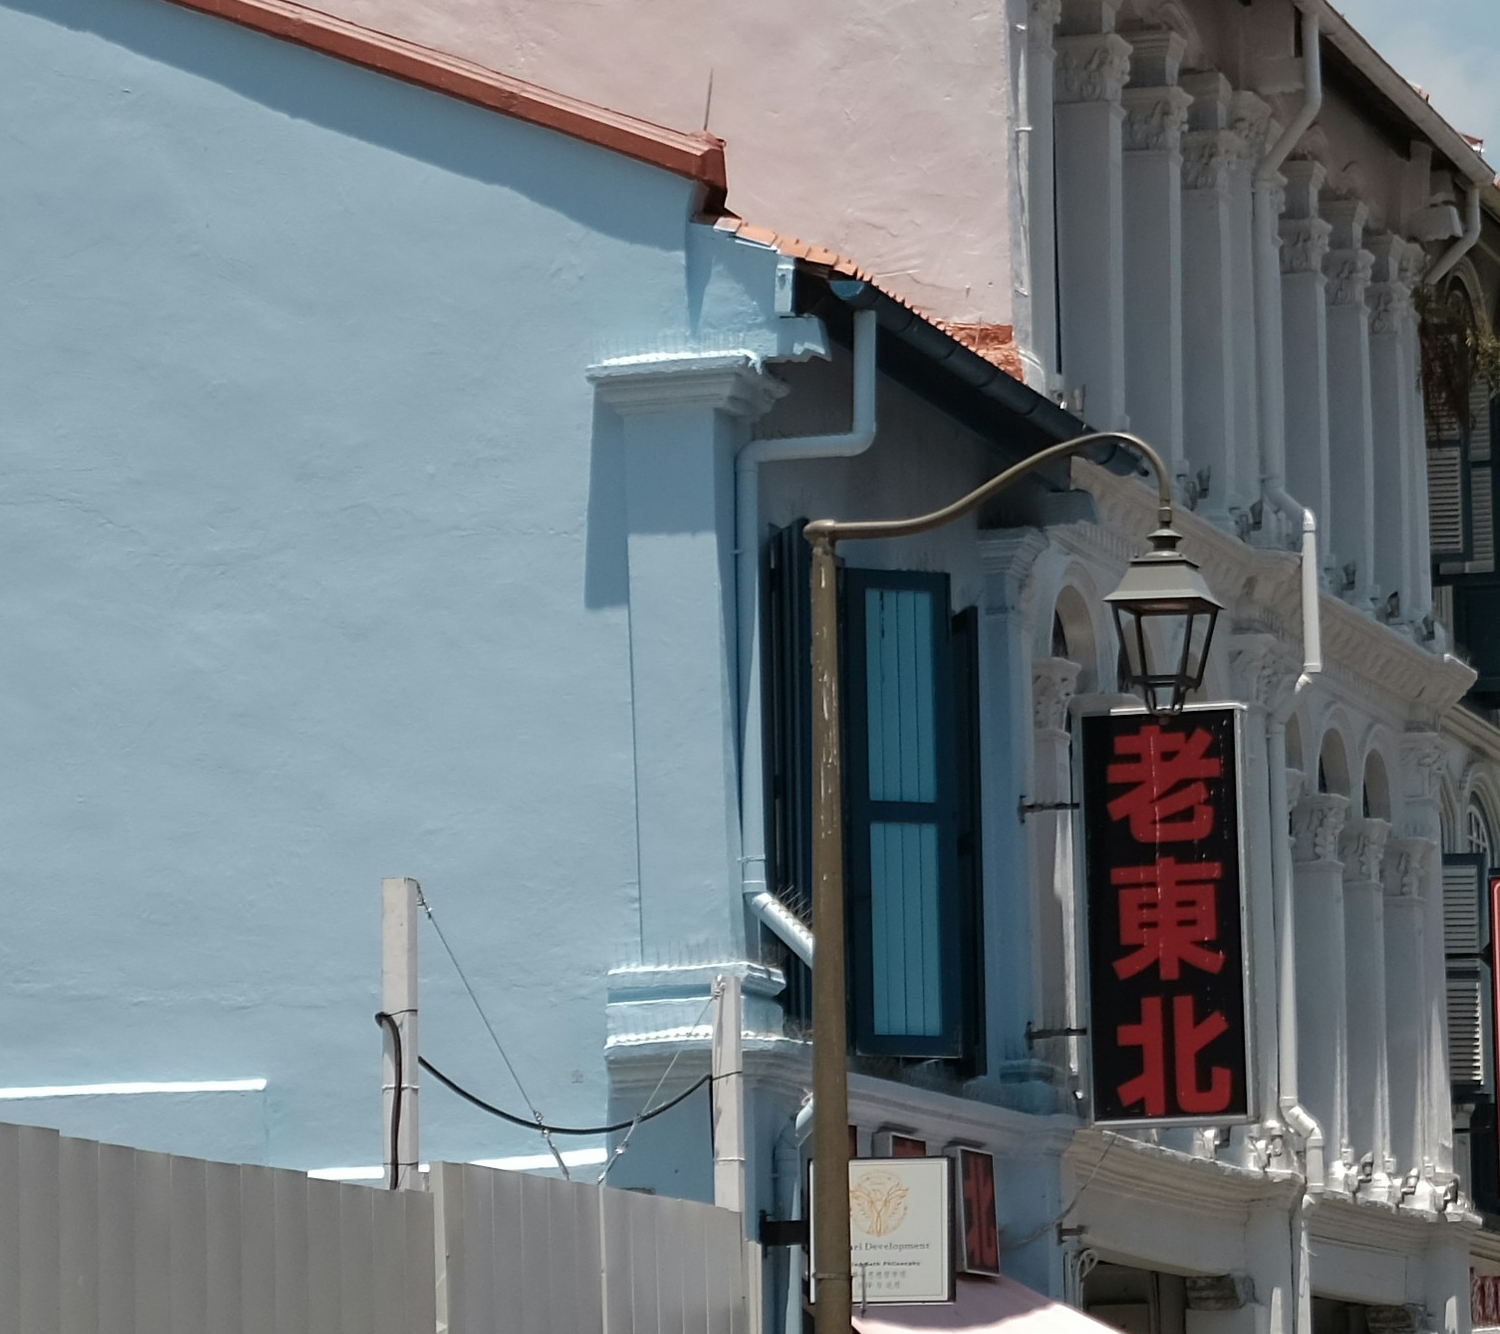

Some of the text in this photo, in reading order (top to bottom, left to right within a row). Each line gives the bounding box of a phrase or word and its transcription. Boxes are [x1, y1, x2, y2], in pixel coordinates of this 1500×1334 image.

[1106, 724, 1233, 1117] 老東北
[865, 1242, 930, 1252] Development
